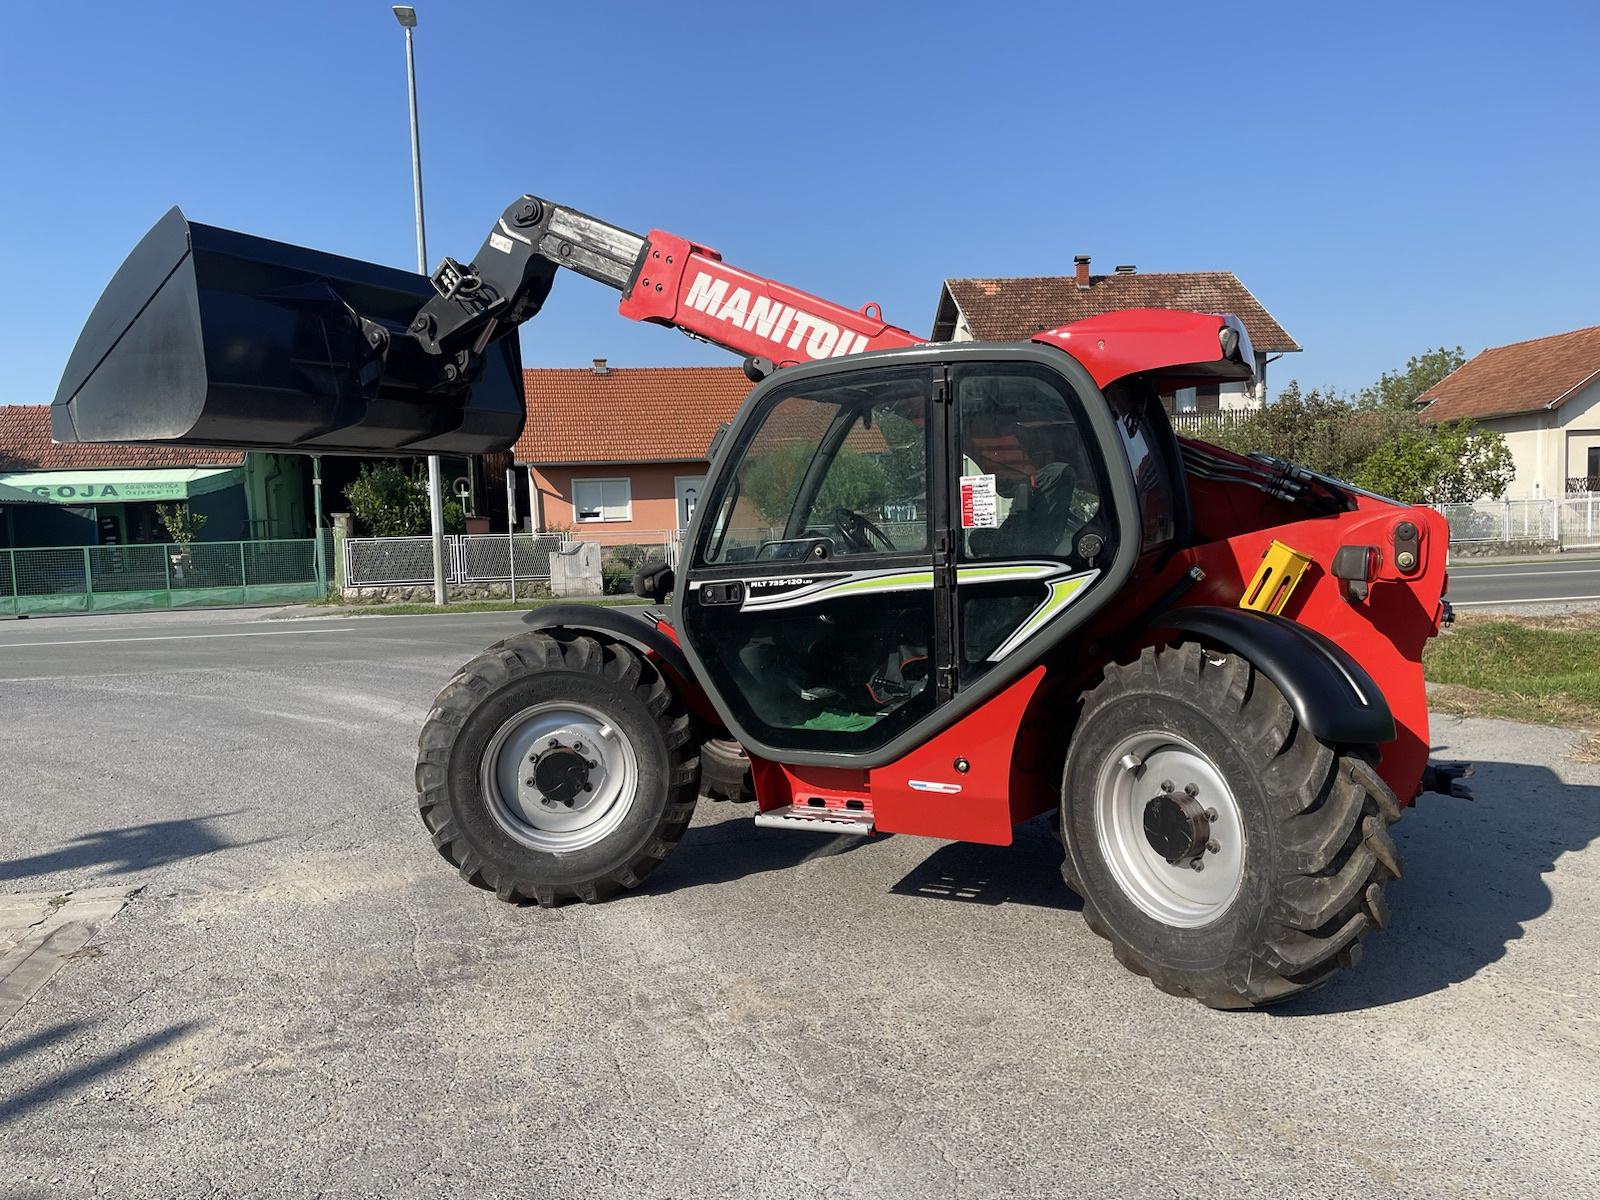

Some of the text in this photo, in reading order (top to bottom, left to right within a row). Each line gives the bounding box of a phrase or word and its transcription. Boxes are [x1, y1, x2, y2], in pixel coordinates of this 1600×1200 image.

[684, 271, 870, 360] MANITOU
[32, 485, 119, 498] GOJA
[768, 579, 803, 587] 735-120
